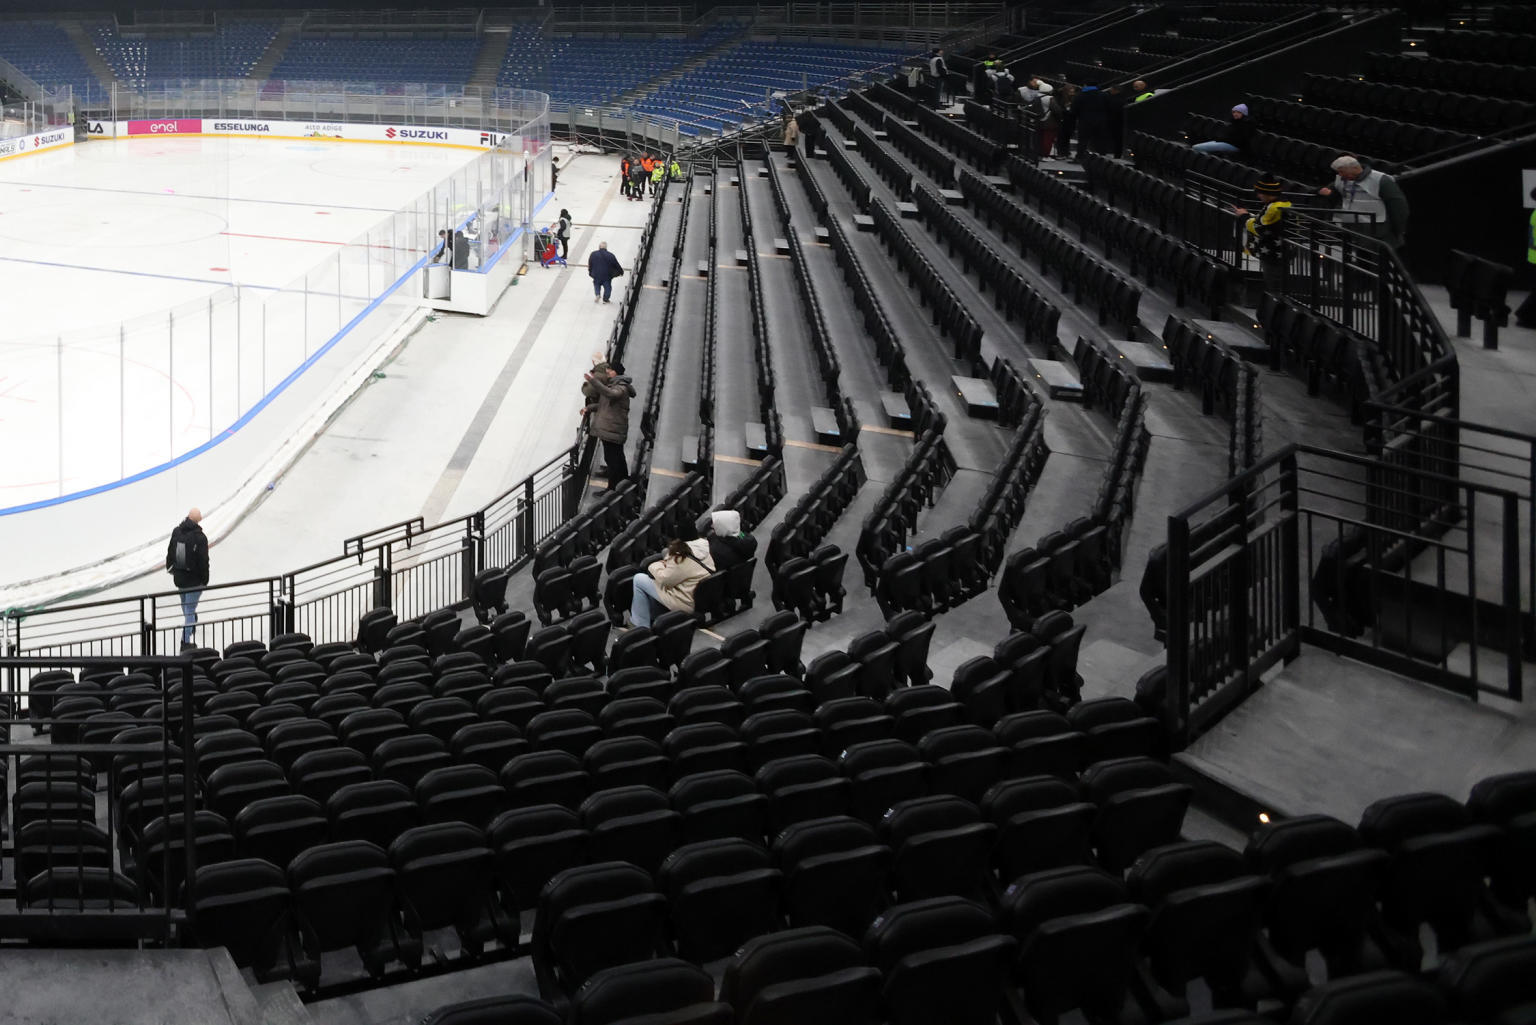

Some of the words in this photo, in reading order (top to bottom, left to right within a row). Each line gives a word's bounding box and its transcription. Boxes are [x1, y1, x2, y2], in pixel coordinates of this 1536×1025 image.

[88, 123, 104, 134] LA
[150, 121, 178, 133] enel
[214, 123, 270, 132] ESSELUNGA
[41, 133, 65, 144] SUZUKI
[400, 129, 448, 140] SUZUKI
